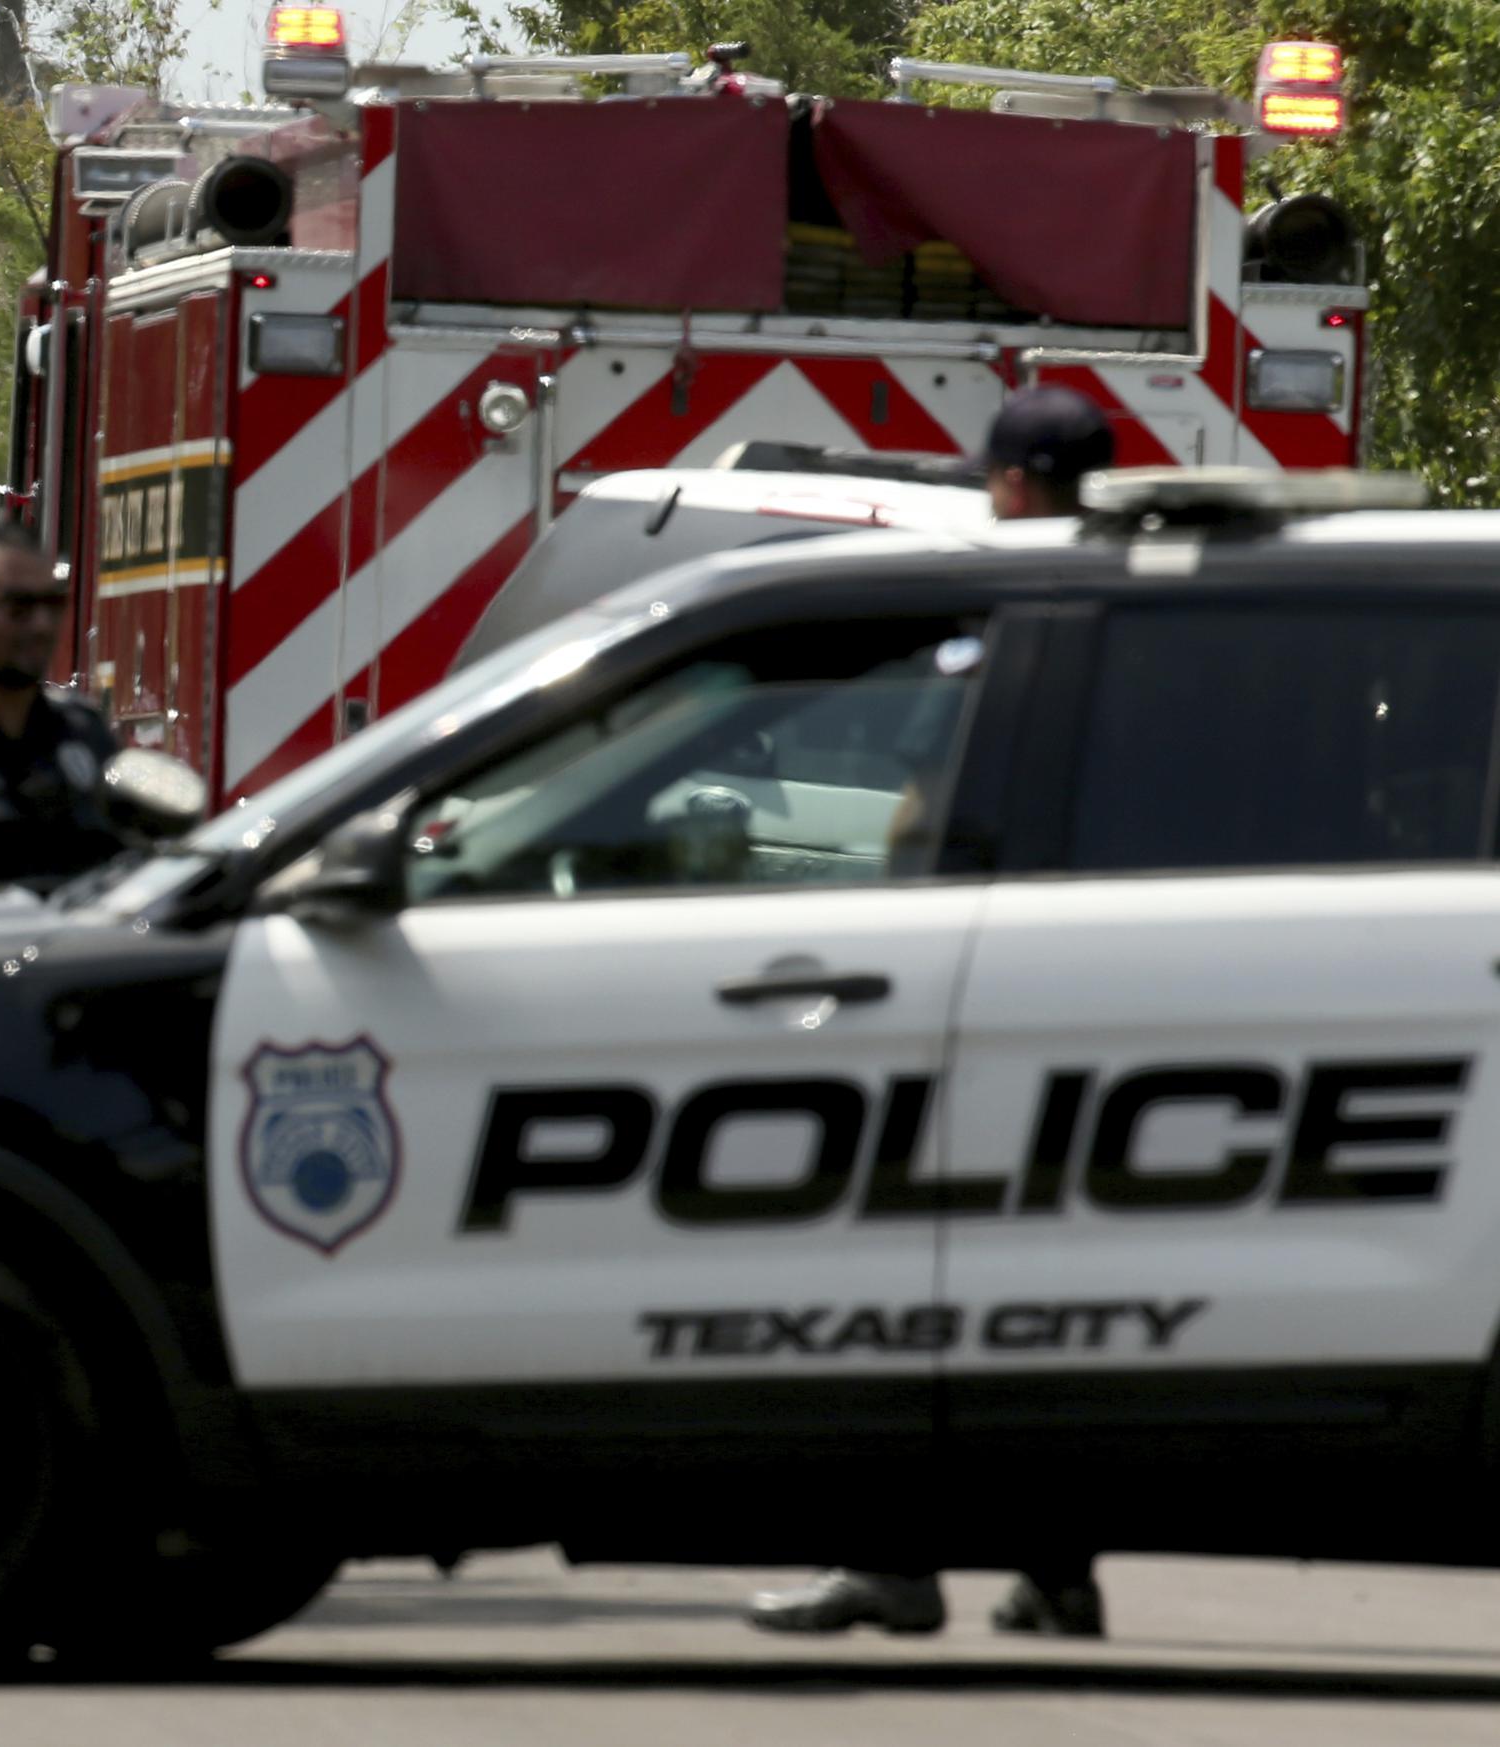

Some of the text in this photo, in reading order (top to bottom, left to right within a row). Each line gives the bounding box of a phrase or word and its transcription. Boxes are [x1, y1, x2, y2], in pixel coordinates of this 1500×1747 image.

[456, 1055, 1475, 1235] POLICE
[636, 1297, 1209, 1357] TEXAS CITY
